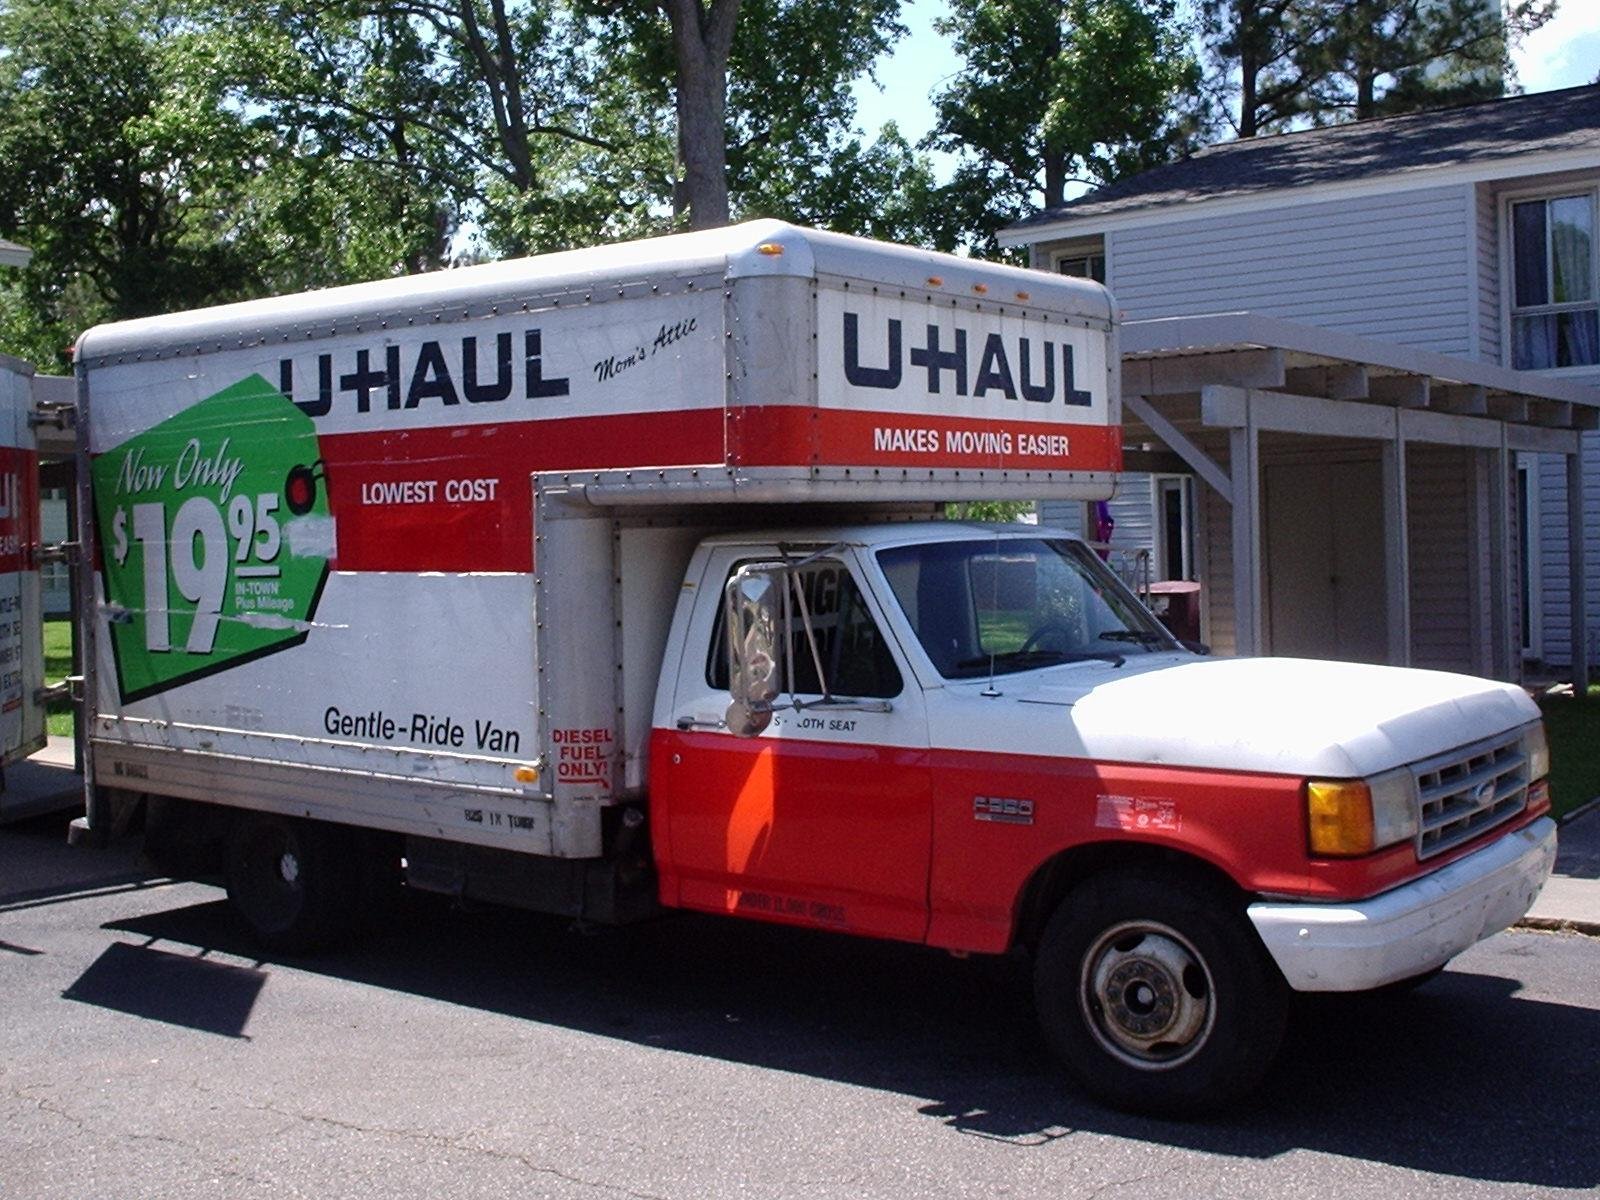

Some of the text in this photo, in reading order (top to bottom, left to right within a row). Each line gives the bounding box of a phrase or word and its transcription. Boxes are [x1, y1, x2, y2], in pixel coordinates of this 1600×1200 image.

[594, 317, 698, 384] Mom's Attic
[874, 428, 1069, 457] MAKES MOVING EASIER
[115, 438, 244, 504] Now Only
[362, 478, 499, 506] LOWEST COST
[234, 582, 279, 596] IN-TOWN
[324, 706, 520, 754] Gentle-Ride Van
[829, 720, 857, 731] SEAT
[552, 729, 613, 744] DIESEL
[560, 746, 607, 760] FUEL
[558, 761, 608, 776] ONLY!
